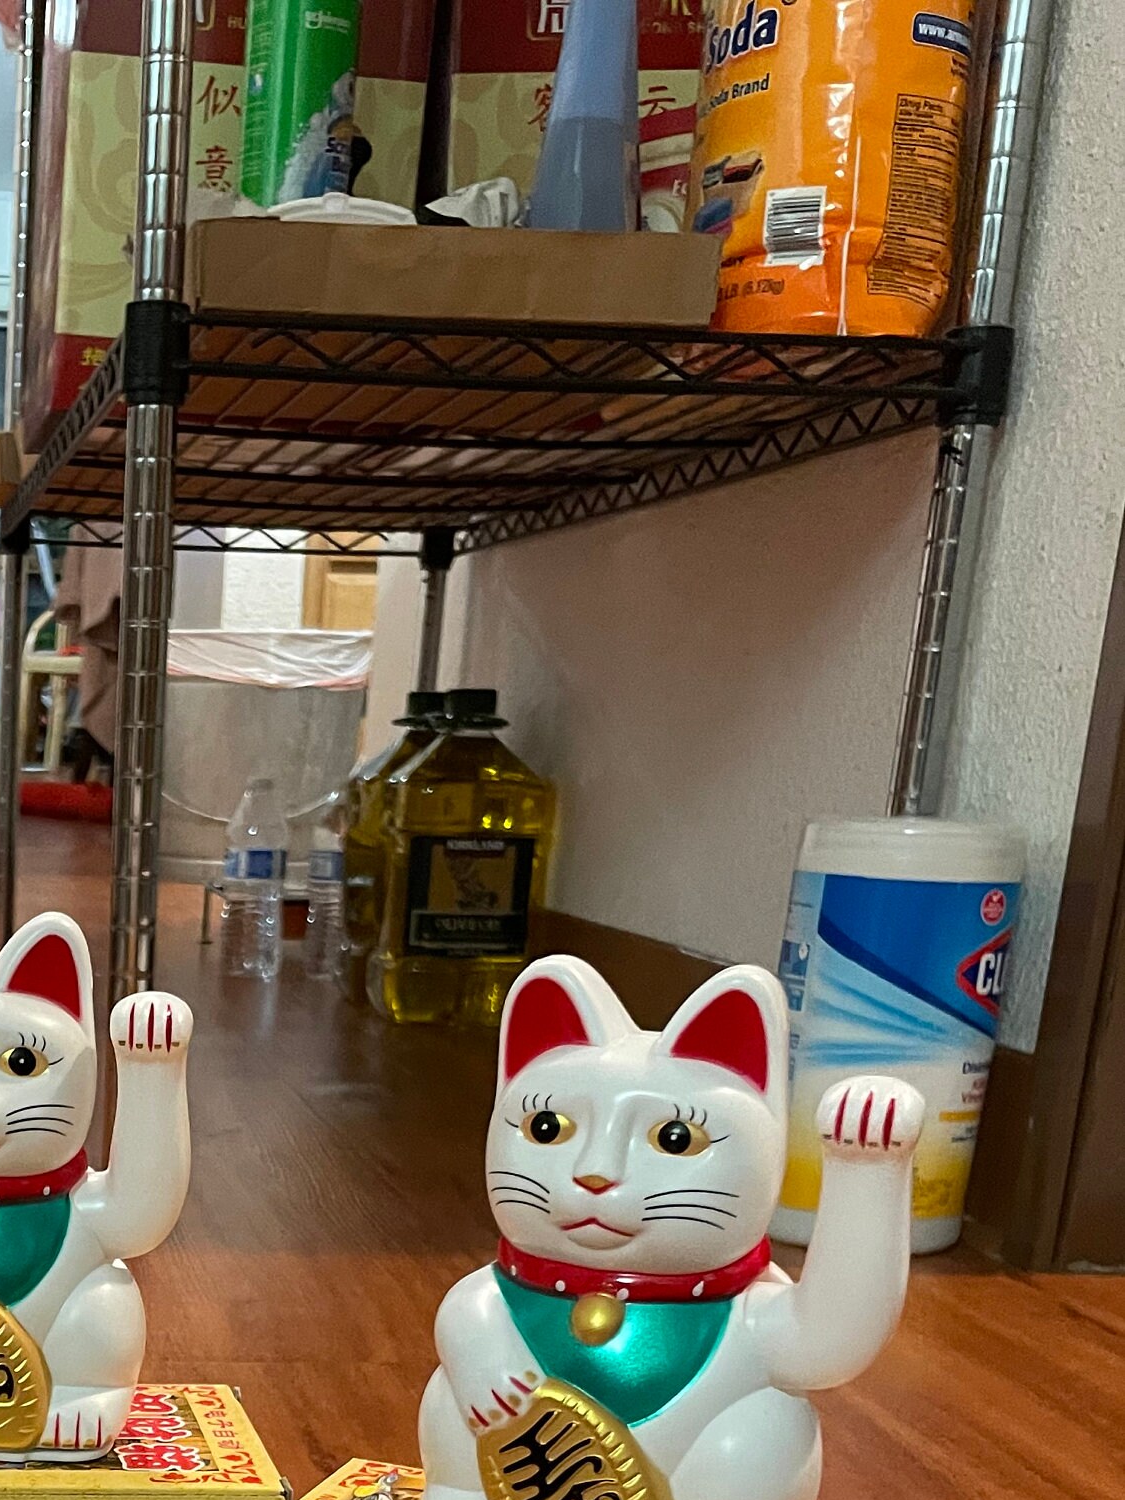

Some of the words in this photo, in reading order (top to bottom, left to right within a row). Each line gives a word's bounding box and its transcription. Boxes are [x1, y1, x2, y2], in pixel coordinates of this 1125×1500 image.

[196, 75, 242, 124] 似
[732, 72, 770, 98] Brand
[203, 1410, 243, 1451] 电子自动
